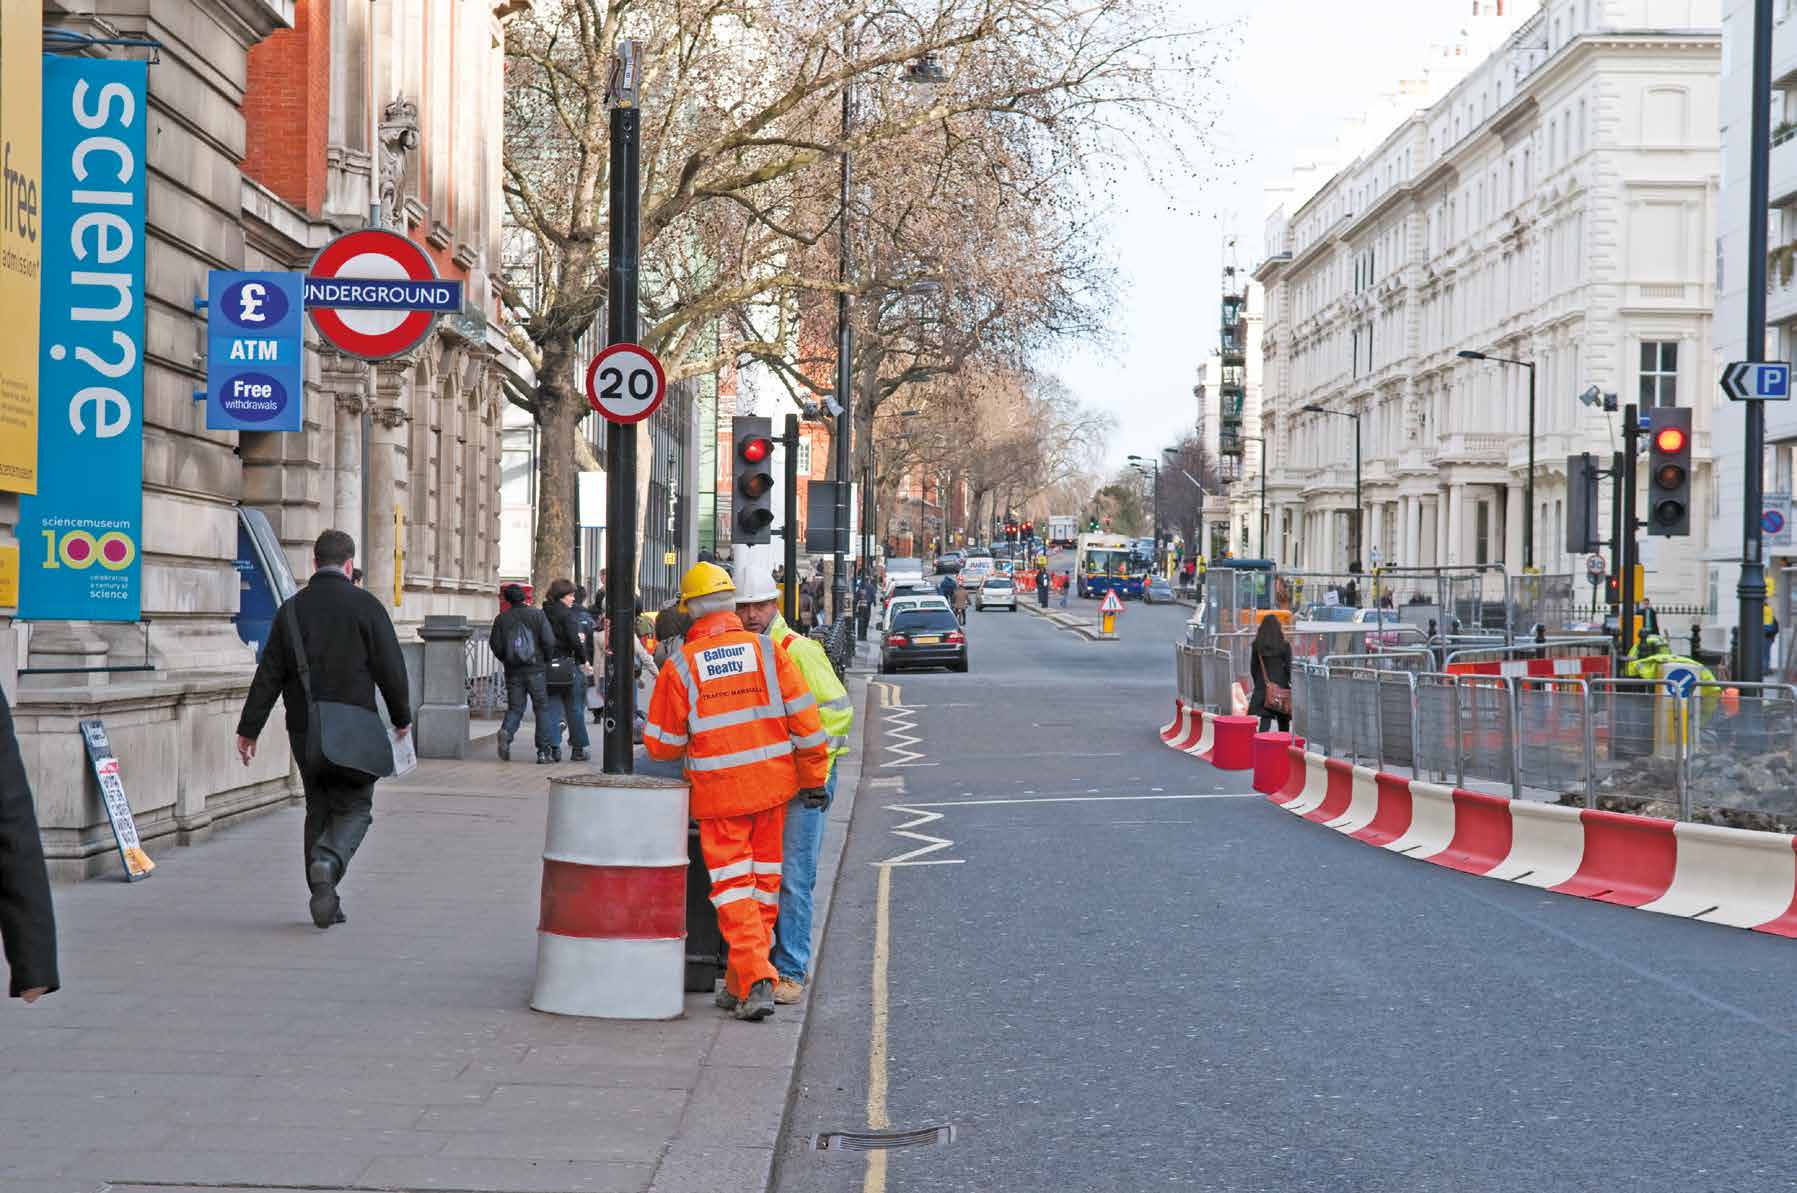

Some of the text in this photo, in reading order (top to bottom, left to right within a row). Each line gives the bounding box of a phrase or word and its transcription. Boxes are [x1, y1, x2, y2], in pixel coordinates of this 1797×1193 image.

[4, 141, 37, 242] free
[240, 283, 266, 322] £
[230, 339, 278, 361] ATM
[233, 381, 272, 398] Free
[600, 367, 654, 400] 20
[1764, 369, 1781, 393] P
[225, 400, 278, 411] withdrawals
[42, 515, 131, 529] sciencemuseum
[41, 530, 135, 571] 100
[90, 589, 128, 599] science
[703, 646, 745, 662] Balfour
[706, 660, 744, 676] Beatty
